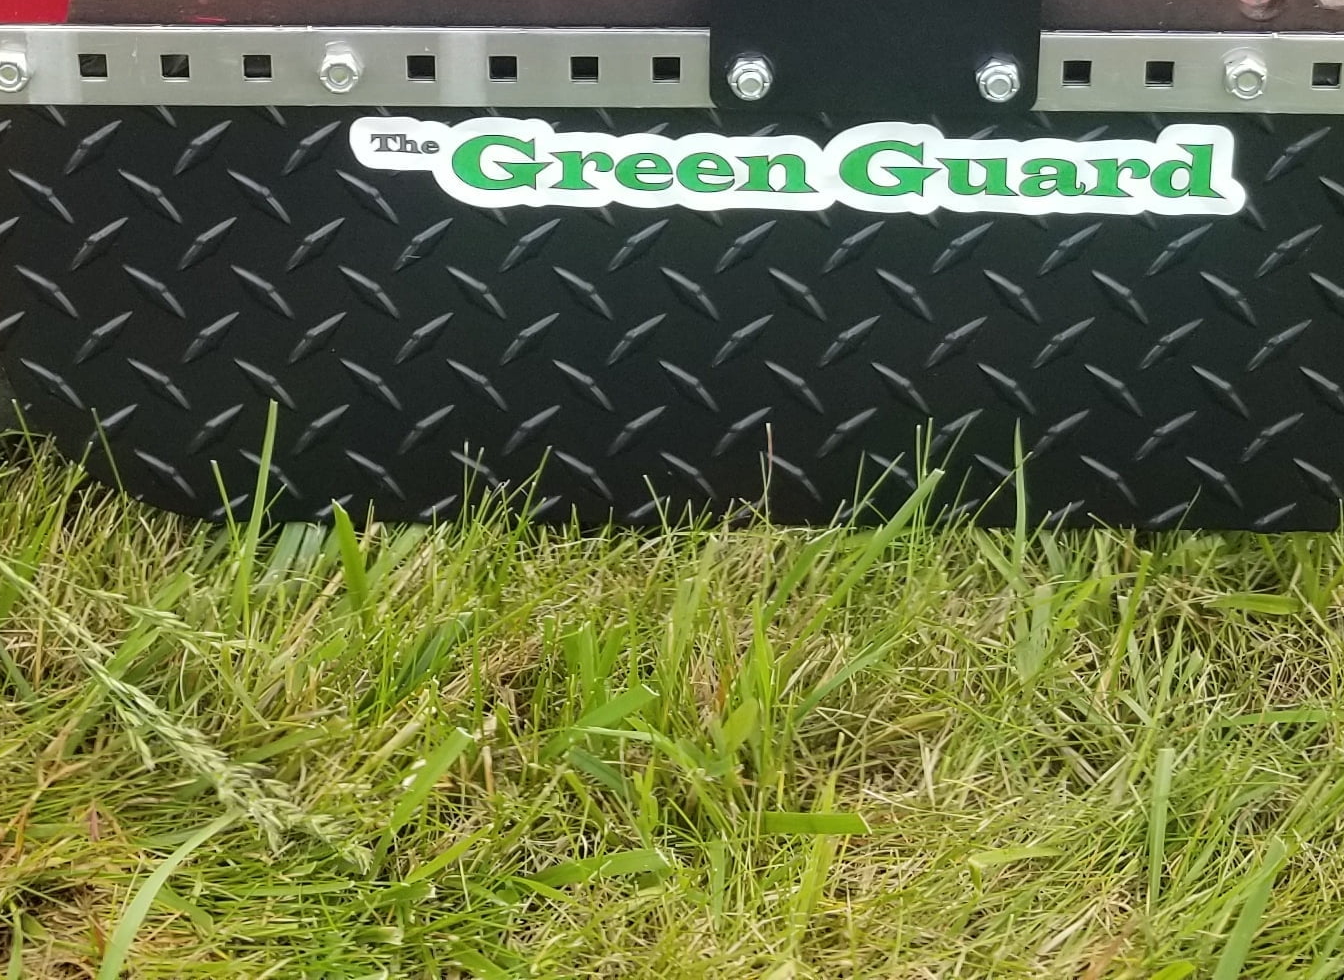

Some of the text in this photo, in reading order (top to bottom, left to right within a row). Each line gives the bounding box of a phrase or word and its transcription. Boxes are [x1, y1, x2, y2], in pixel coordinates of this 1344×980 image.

[370, 132, 1228, 199] The Green Guard
